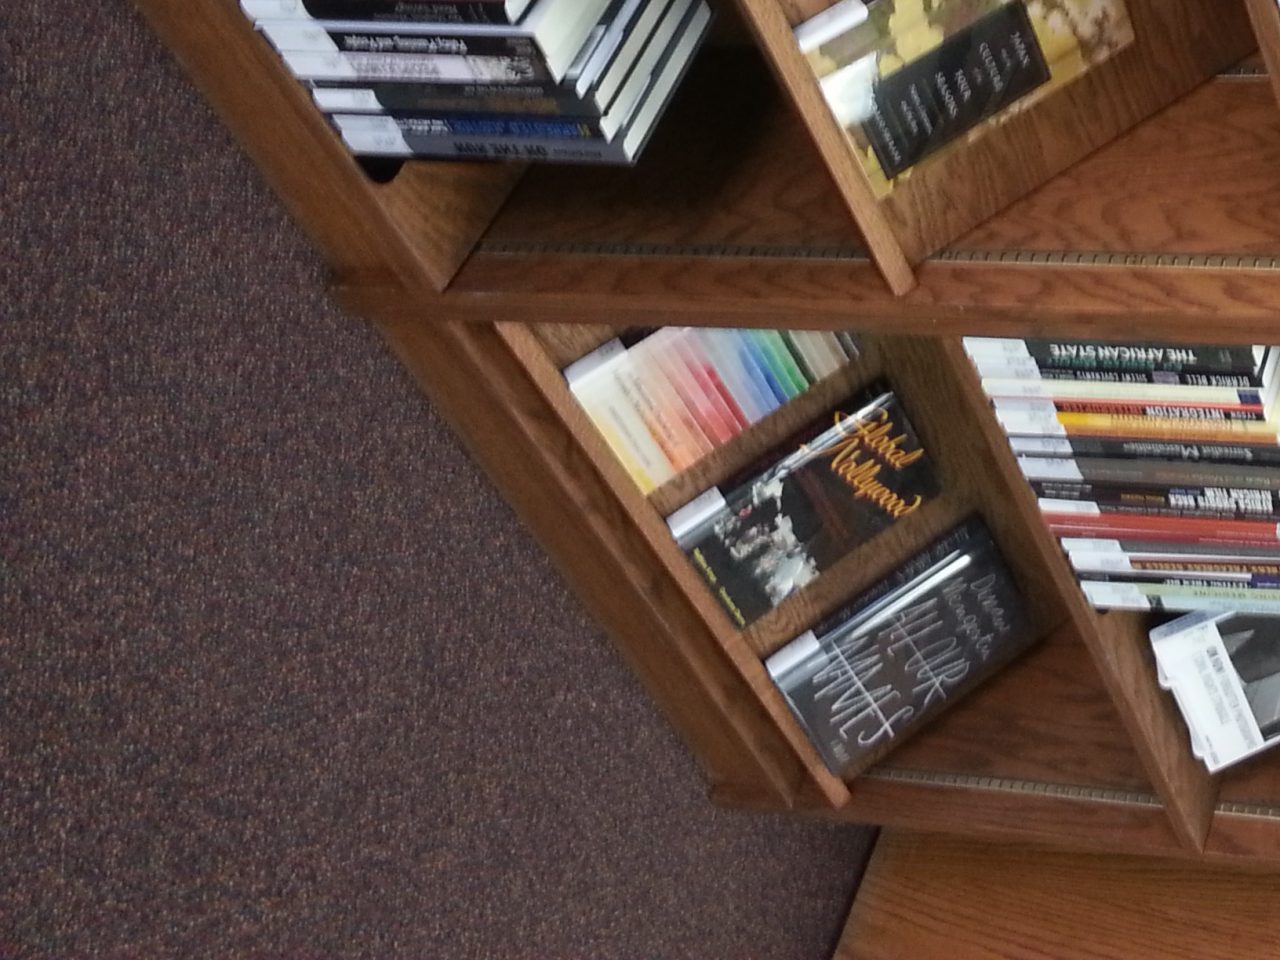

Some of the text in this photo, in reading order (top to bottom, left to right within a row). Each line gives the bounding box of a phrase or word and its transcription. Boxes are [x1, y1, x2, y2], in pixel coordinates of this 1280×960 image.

[1009, 31, 1030, 68] JAPAN
[490, 143, 519, 156] THE
[1048, 343, 1198, 364] THE AFRICAN STATE
[1184, 373, 1250, 388] DERRICK BELL
[1145, 405, 1227, 419] INTEGRATION
[1122, 441, 1253, 457] Surrealist Masculinities
[821, 437, 922, 518] Nollywood
[1168, 493, 1197, 510] BACK
[878, 597, 944, 657] ALL
[904, 636, 970, 710] OUR
[812, 636, 914, 745] NAMES
